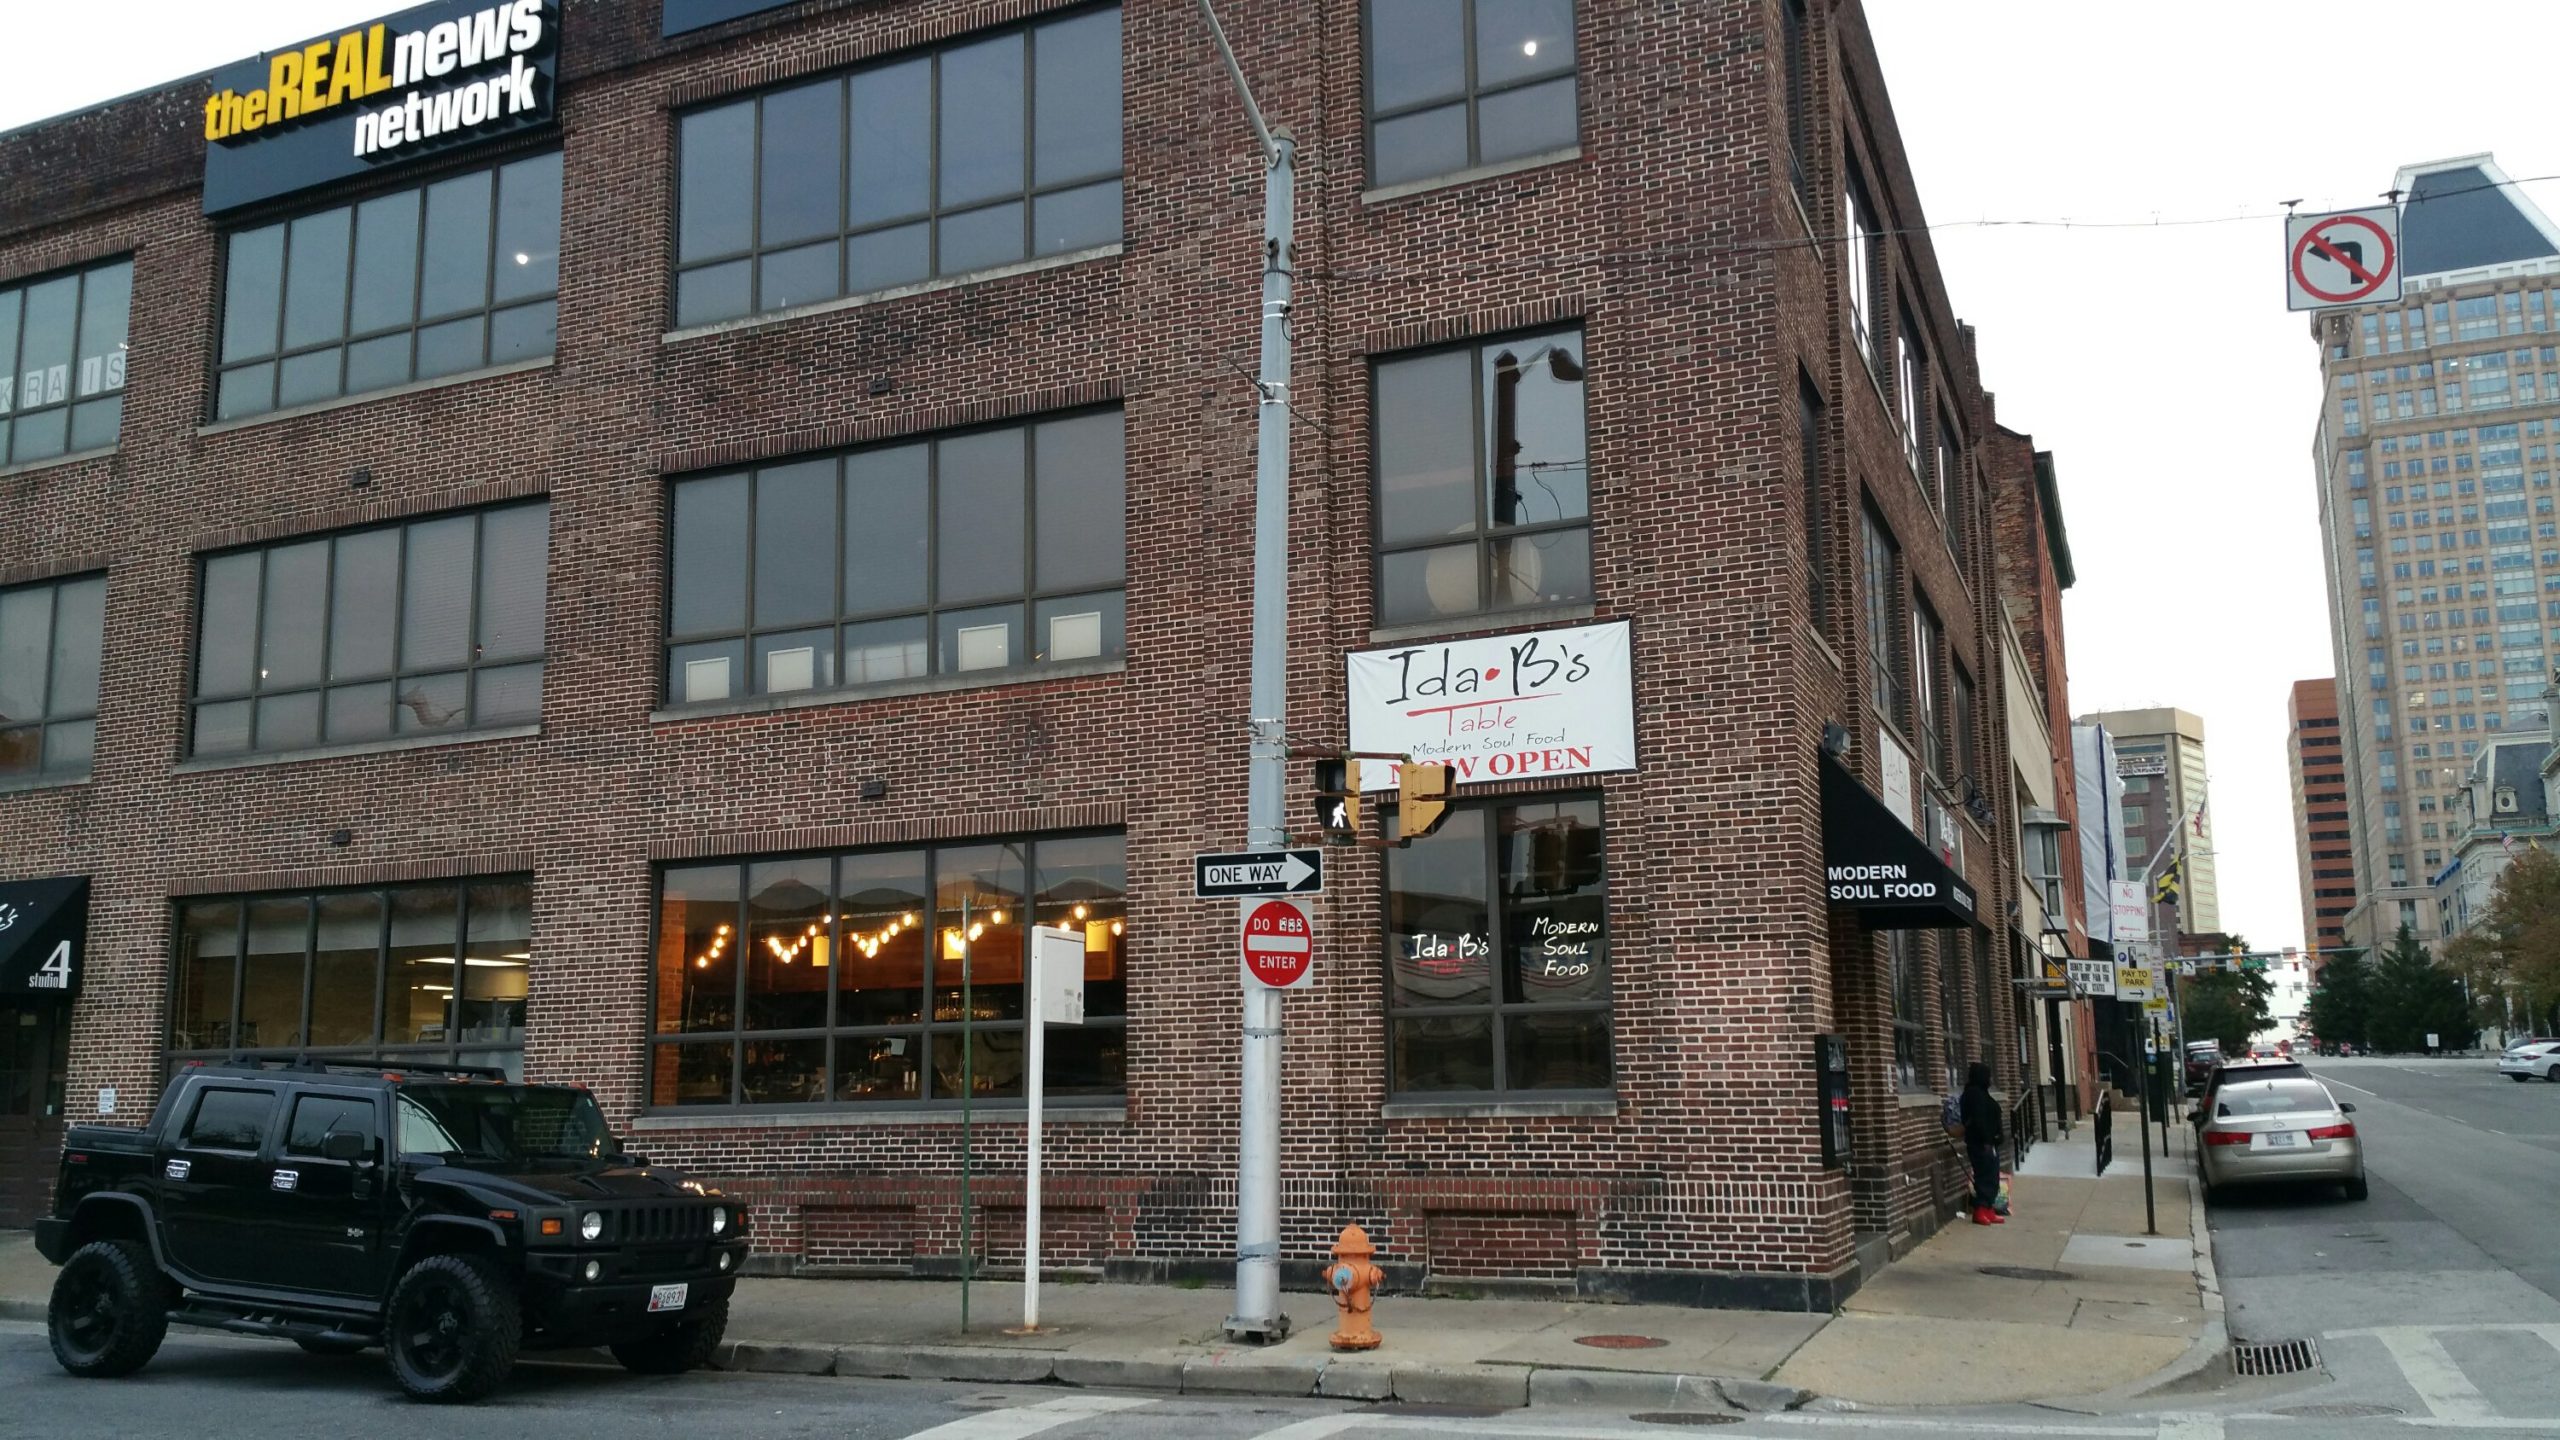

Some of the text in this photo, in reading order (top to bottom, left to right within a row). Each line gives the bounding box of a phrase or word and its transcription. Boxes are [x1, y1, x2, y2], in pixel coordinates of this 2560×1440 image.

[353, 54, 537, 157] network
[1448, 706, 1517, 736] Table
[1412, 728, 1565, 756] Modern Soul Food
[1488, 745, 1593, 776] OPEN
[1209, 865, 1283, 883] ONE WAY
[1828, 864, 1907, 881] MODERN
[1830, 884, 1880, 900] SOUL
[1883, 882, 1936, 899] FOOD
[1253, 918, 1270, 931] DO
[1531, 916, 1599, 936] MODERN
[1543, 936, 1589, 956] SOUL
[41, 940, 72, 988] 4
[1259, 956, 1297, 969] ENTER
[1544, 959, 1589, 976] FOOD
[29, 972, 59, 988] studio
[2125, 978, 2145, 986] PARK
[2137, 970, 2147, 978] TO
